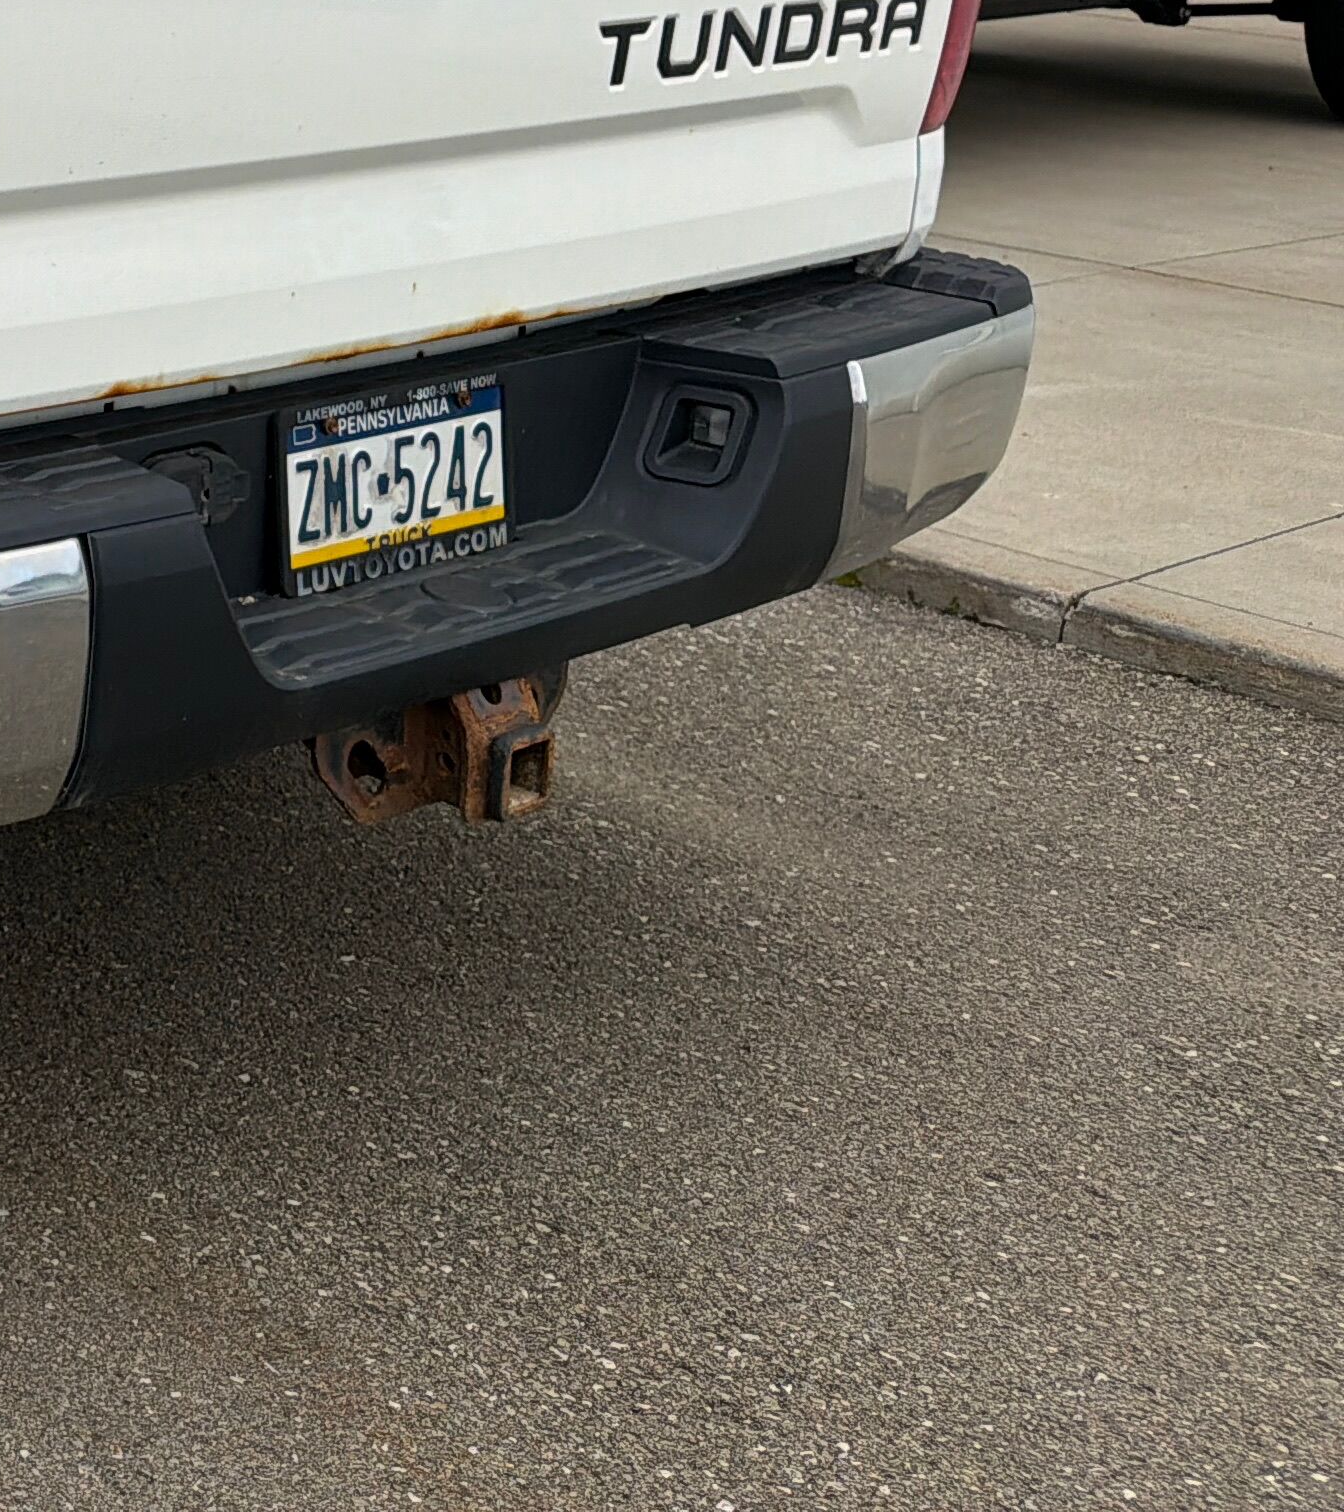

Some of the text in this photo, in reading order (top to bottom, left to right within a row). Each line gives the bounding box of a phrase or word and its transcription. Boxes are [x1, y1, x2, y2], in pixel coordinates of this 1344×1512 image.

[297, 373, 497, 424] LAKEWOOD, NY 1-800-SAVE NOW
[338, 396, 450, 437] PENNSYLVANIA
[296, 523, 508, 596] LUVTOYOTA.COM
